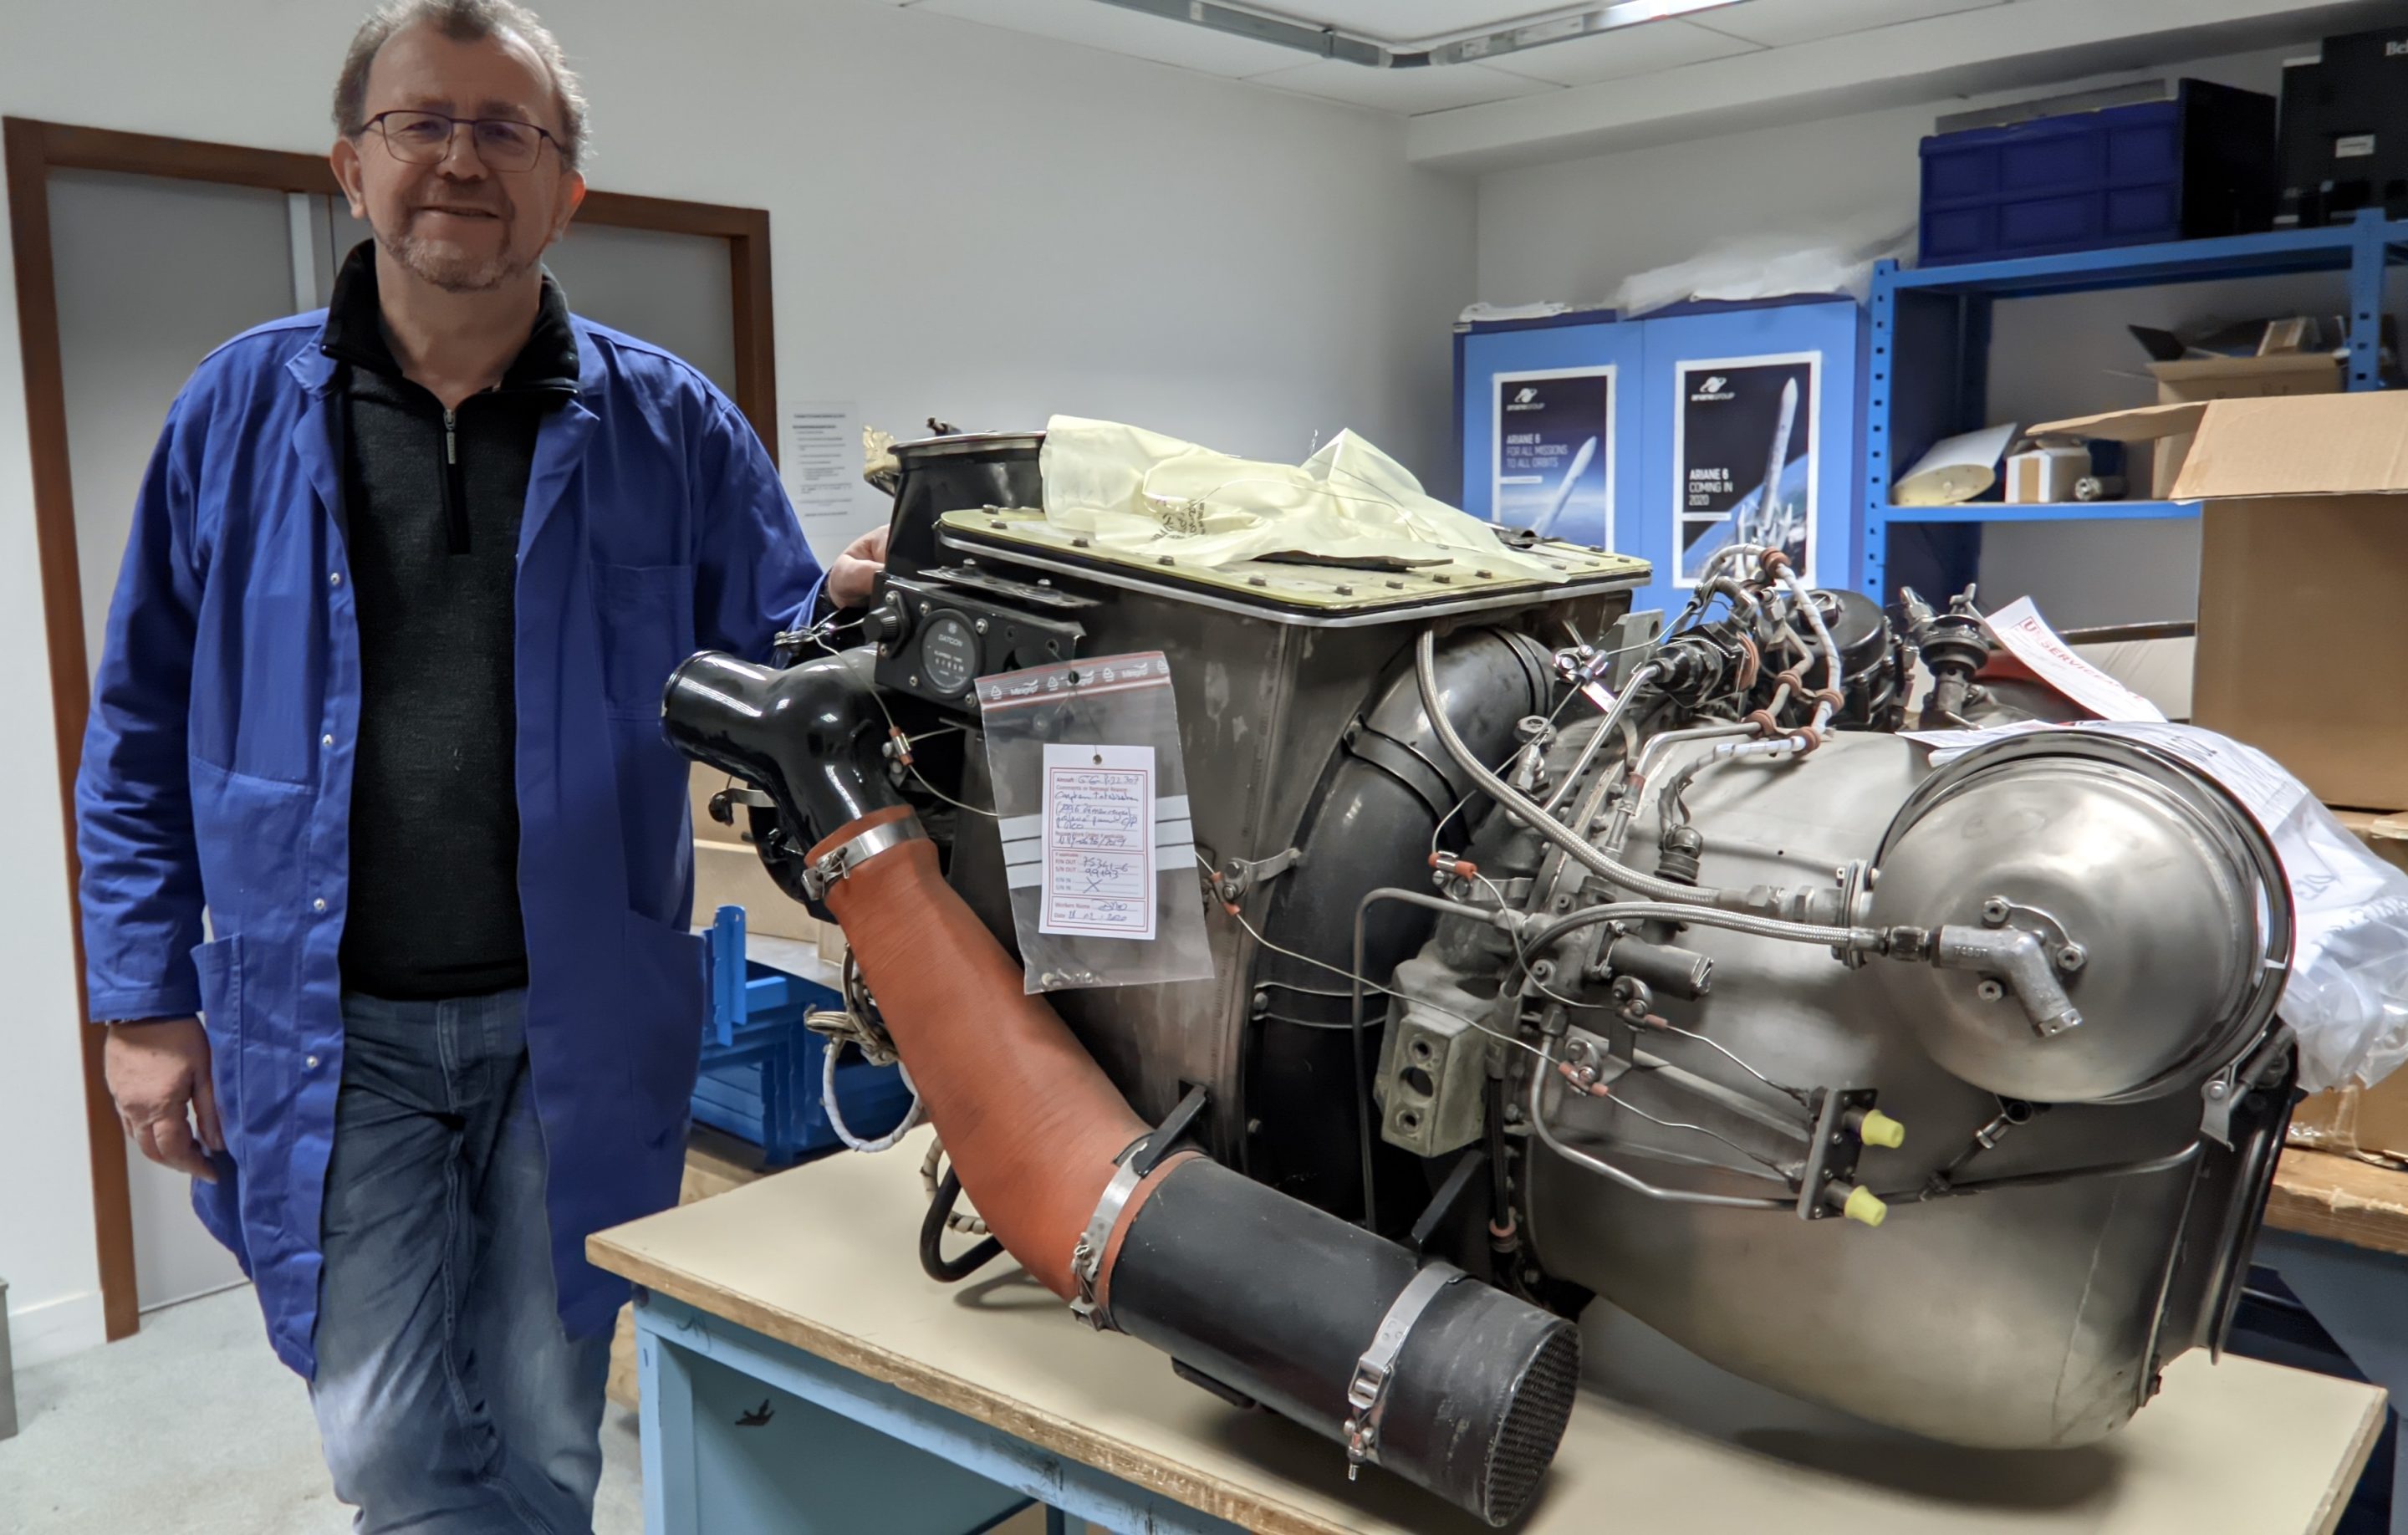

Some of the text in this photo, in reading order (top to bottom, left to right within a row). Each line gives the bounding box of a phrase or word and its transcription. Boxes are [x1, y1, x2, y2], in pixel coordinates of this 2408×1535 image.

[1507, 433, 1541, 445] ARIANE 6
[1507, 444, 1568, 456] FOR ALL MISSIONS
[1507, 456, 1559, 468] TO ALL ORBITS
[1689, 468, 1729, 481] ARIANE 6
[1689, 481, 1733, 493] COMING IN
[1689, 494, 1710, 506] 2020
[938, 634, 963, 647] DATCON
